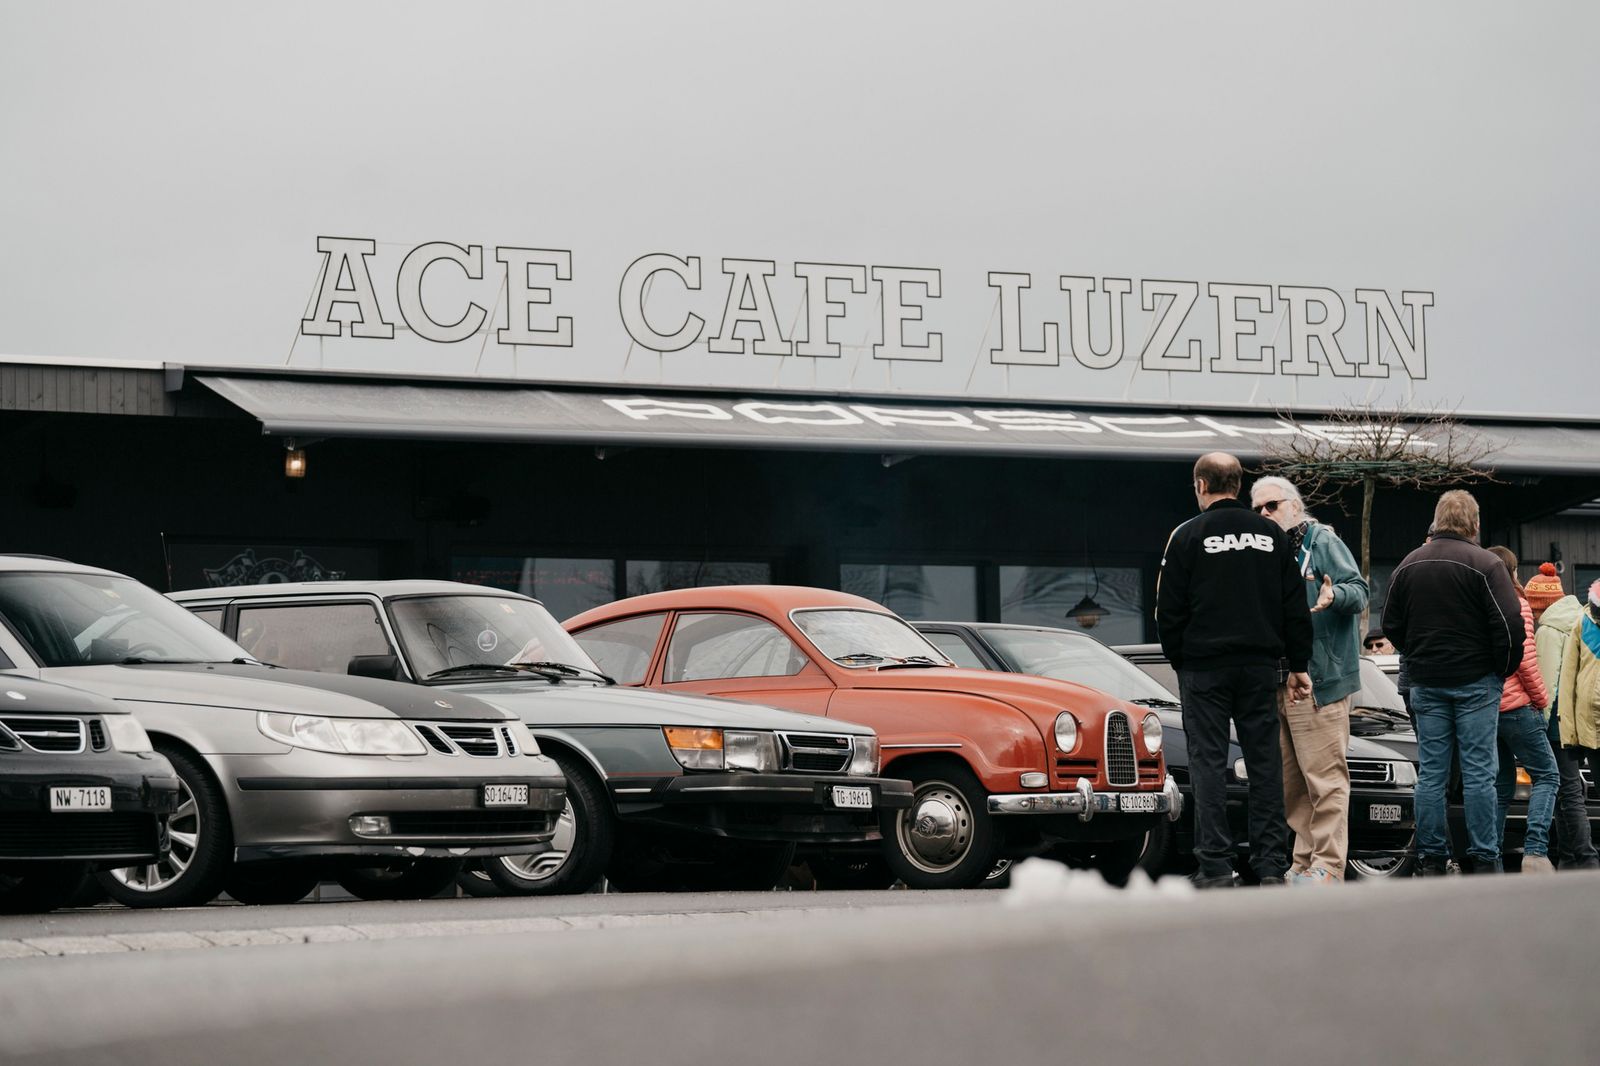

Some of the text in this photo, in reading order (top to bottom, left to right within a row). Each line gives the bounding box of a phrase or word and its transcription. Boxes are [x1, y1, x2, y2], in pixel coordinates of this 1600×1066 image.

[301, 236, 1435, 380] ACE CAFE LUZERN
[602, 398, 1438, 447] PORSCHE
[1203, 533, 1274, 553] SAAB
